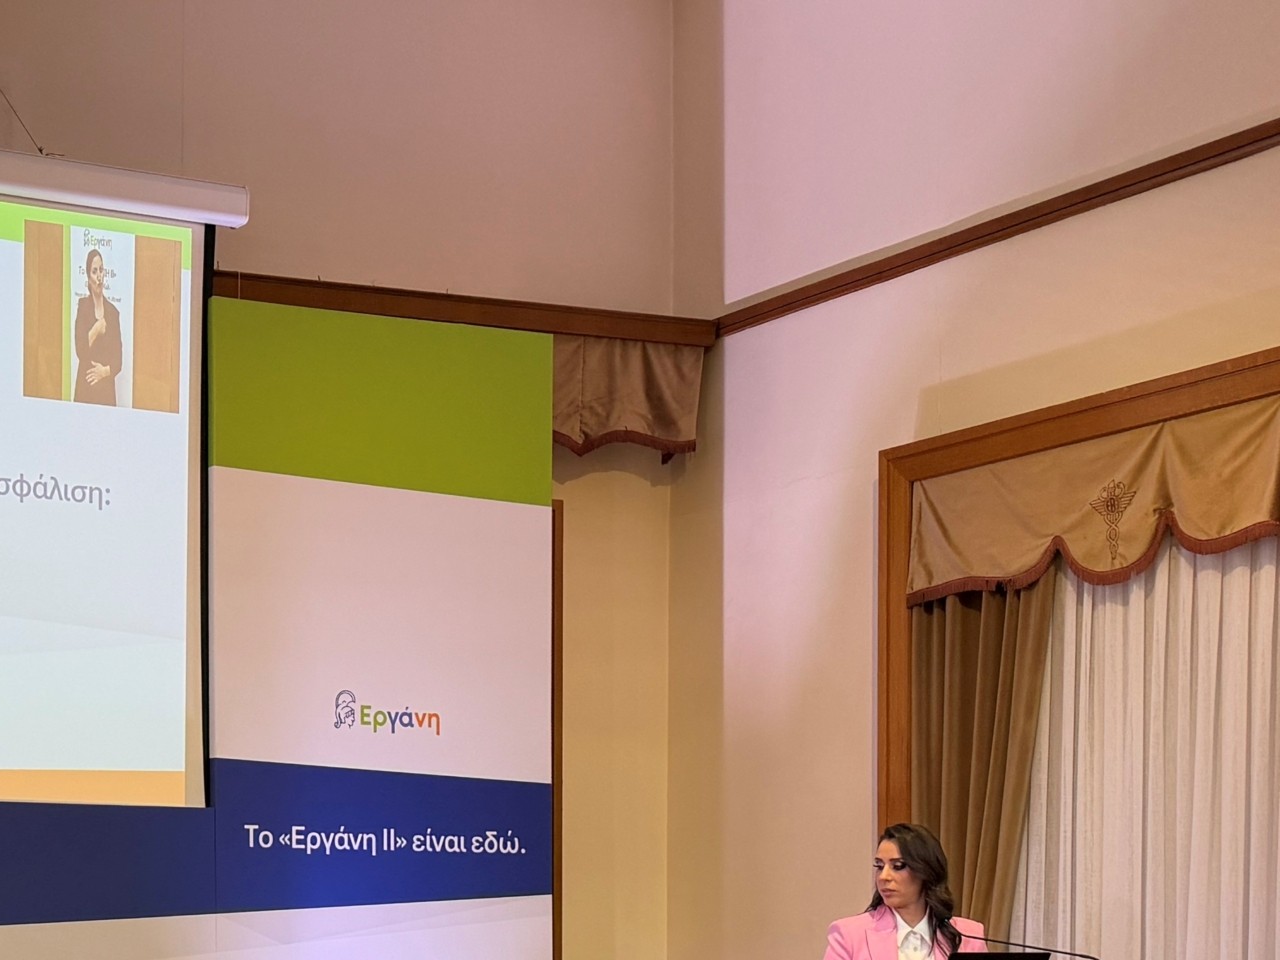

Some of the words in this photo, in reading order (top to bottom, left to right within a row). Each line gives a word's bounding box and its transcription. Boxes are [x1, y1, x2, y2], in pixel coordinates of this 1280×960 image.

[360, 705, 440, 735] Εργάνη
[244, 825, 274, 848] Το
[279, 826, 376, 856] «Εργάνη
[412, 826, 466, 853] είναι
[471, 830, 526, 854] εδώ.
